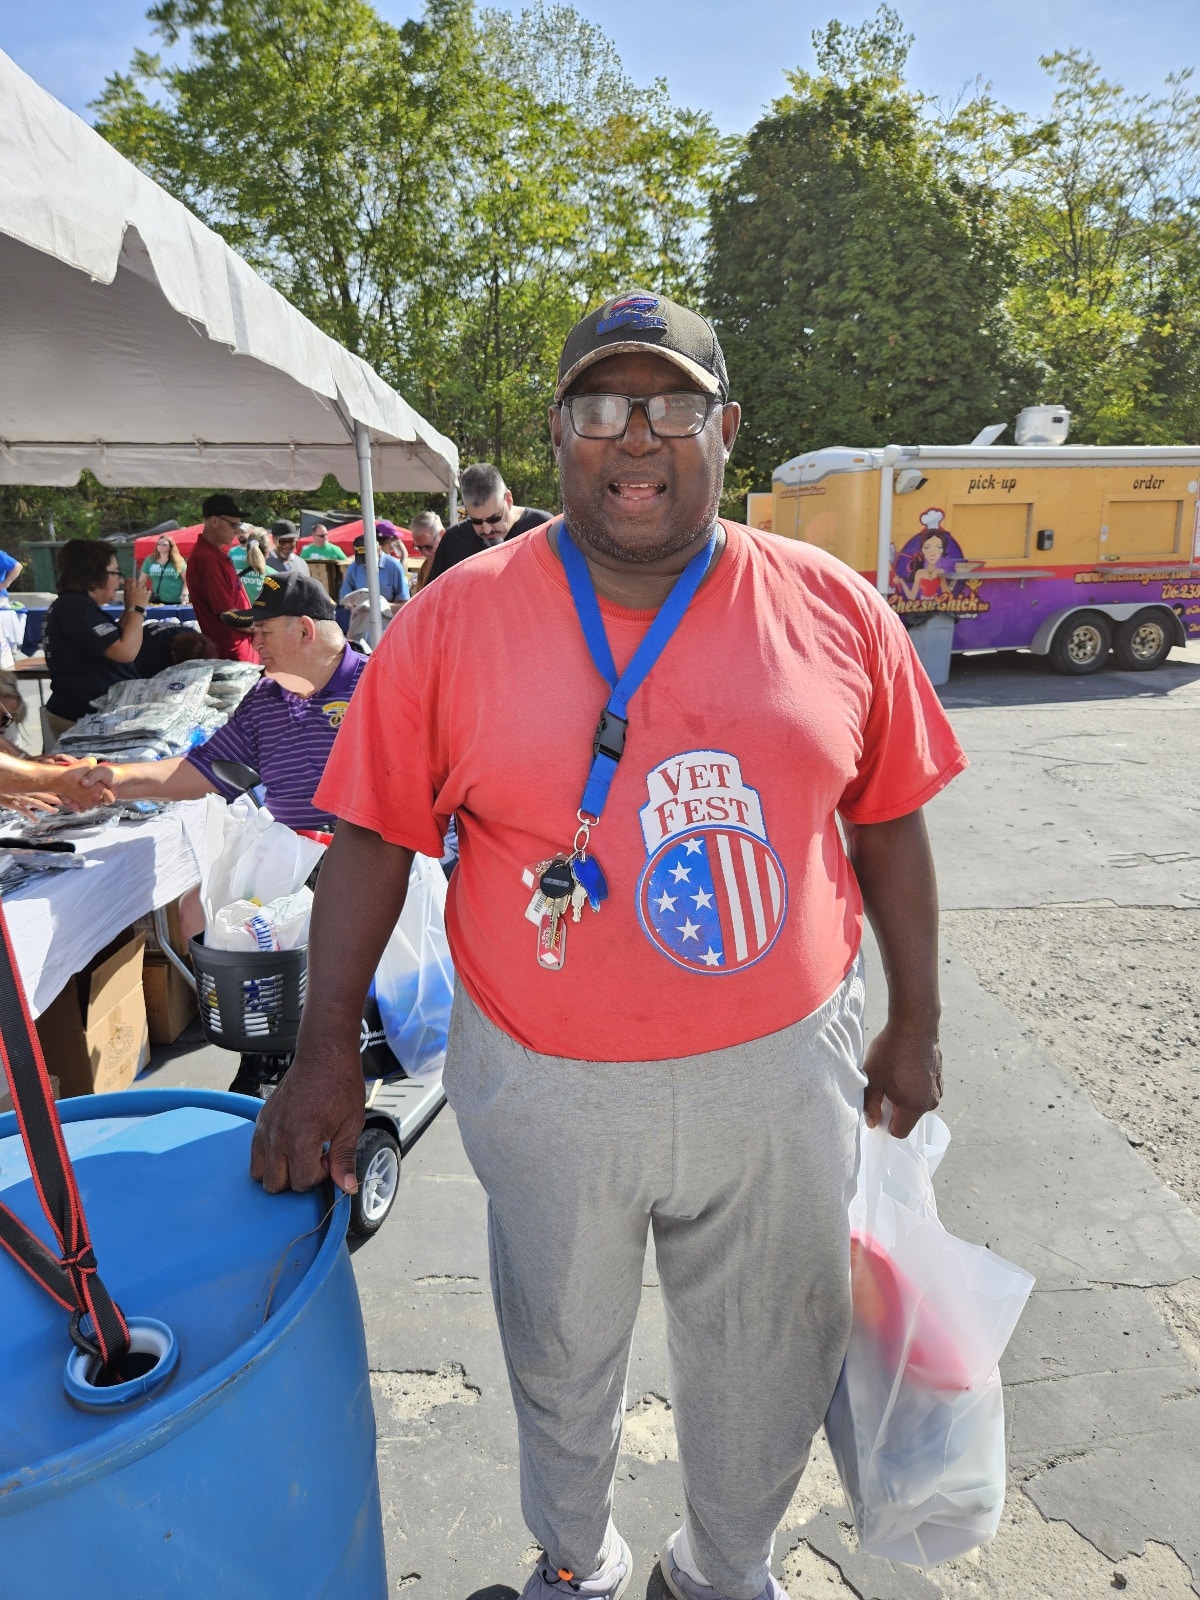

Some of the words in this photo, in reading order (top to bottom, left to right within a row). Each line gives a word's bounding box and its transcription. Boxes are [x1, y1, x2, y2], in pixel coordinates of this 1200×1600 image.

[968, 475, 1017, 494] pick-up
[1133, 475, 1165, 490] order
[658, 761, 730, 796] VET
[653, 796, 749, 839] FEST
